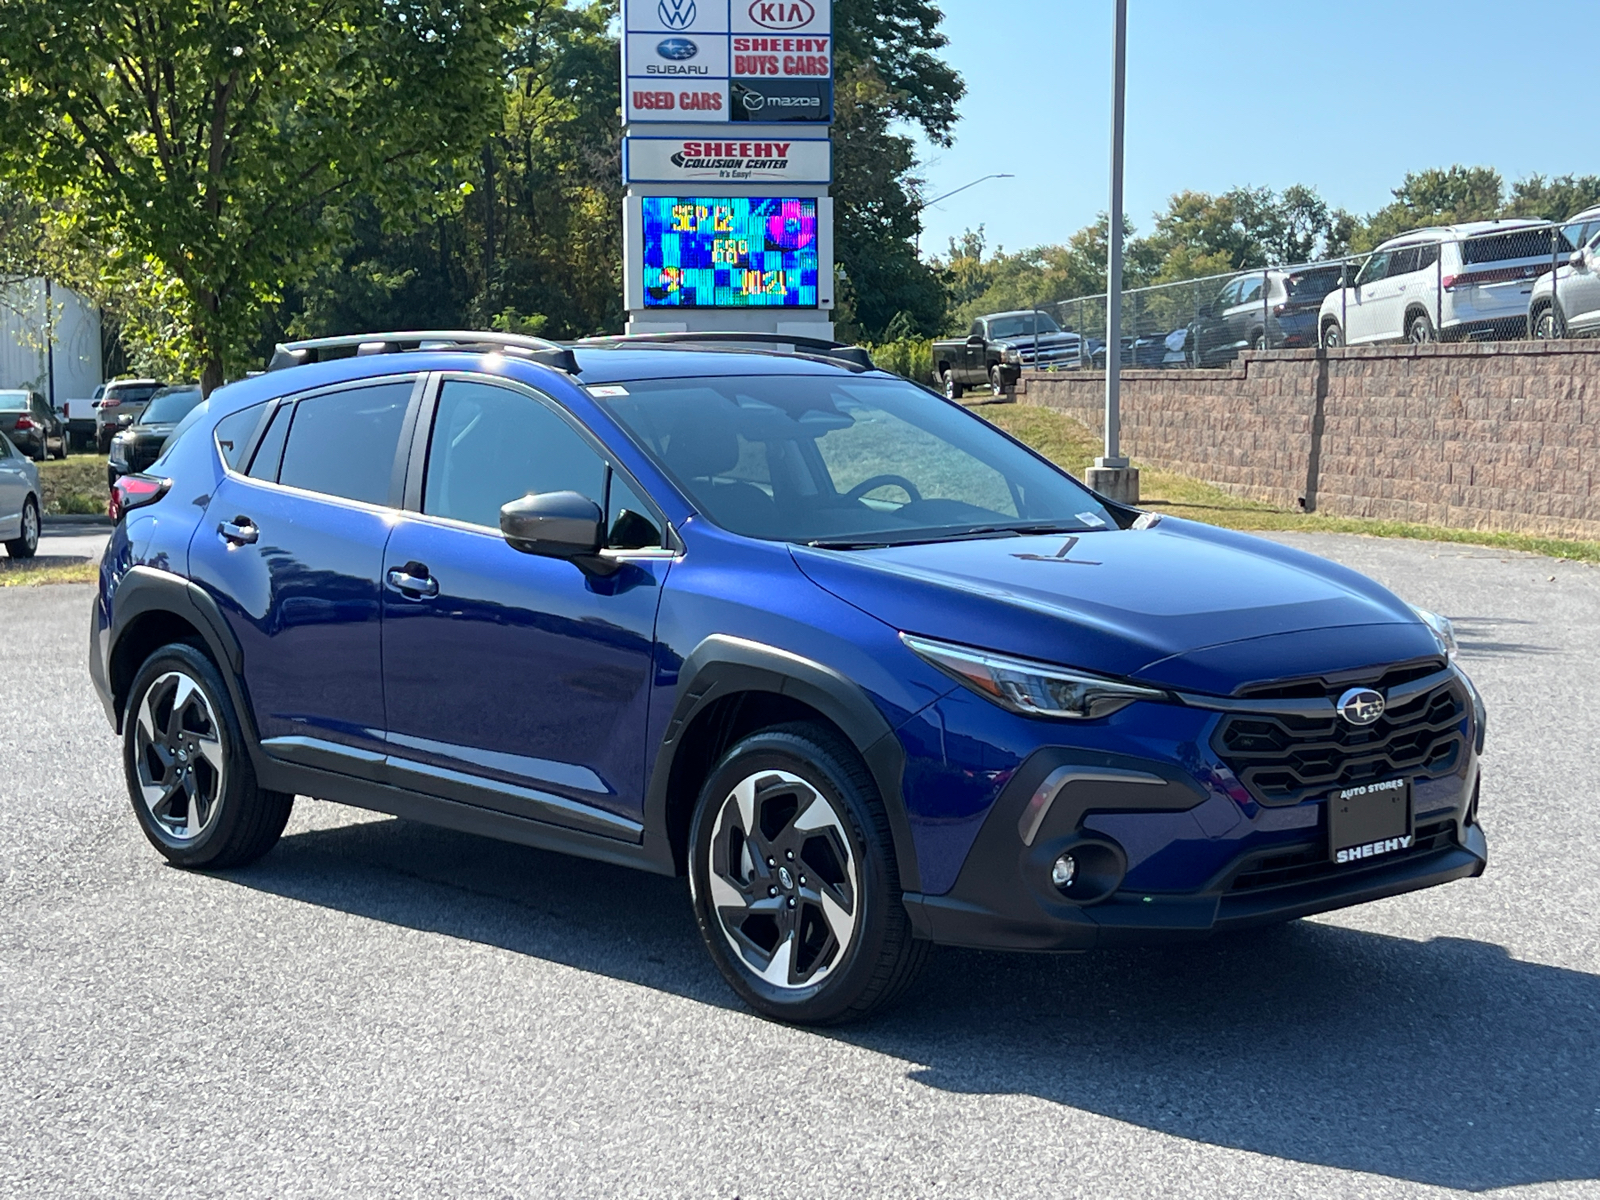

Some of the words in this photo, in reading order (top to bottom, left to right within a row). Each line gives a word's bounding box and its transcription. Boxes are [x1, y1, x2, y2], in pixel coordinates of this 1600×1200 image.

[760, 3, 804, 22] KIA
[733, 38, 828, 52] SHEEHY
[646, 65, 708, 75] SUBARU
[734, 55, 779, 75] BUYS
[783, 55, 829, 76] CARS
[633, 91, 675, 110] USED
[679, 92, 722, 111] CARS
[683, 142, 791, 158] SHEEHY
[684, 159, 742, 169] COLLISION
[745, 159, 788, 169] CENTER
[1340, 786, 1367, 799] AUTO
[1368, 779, 1404, 793] STORES
[1336, 835, 1412, 863] SHEEHY
